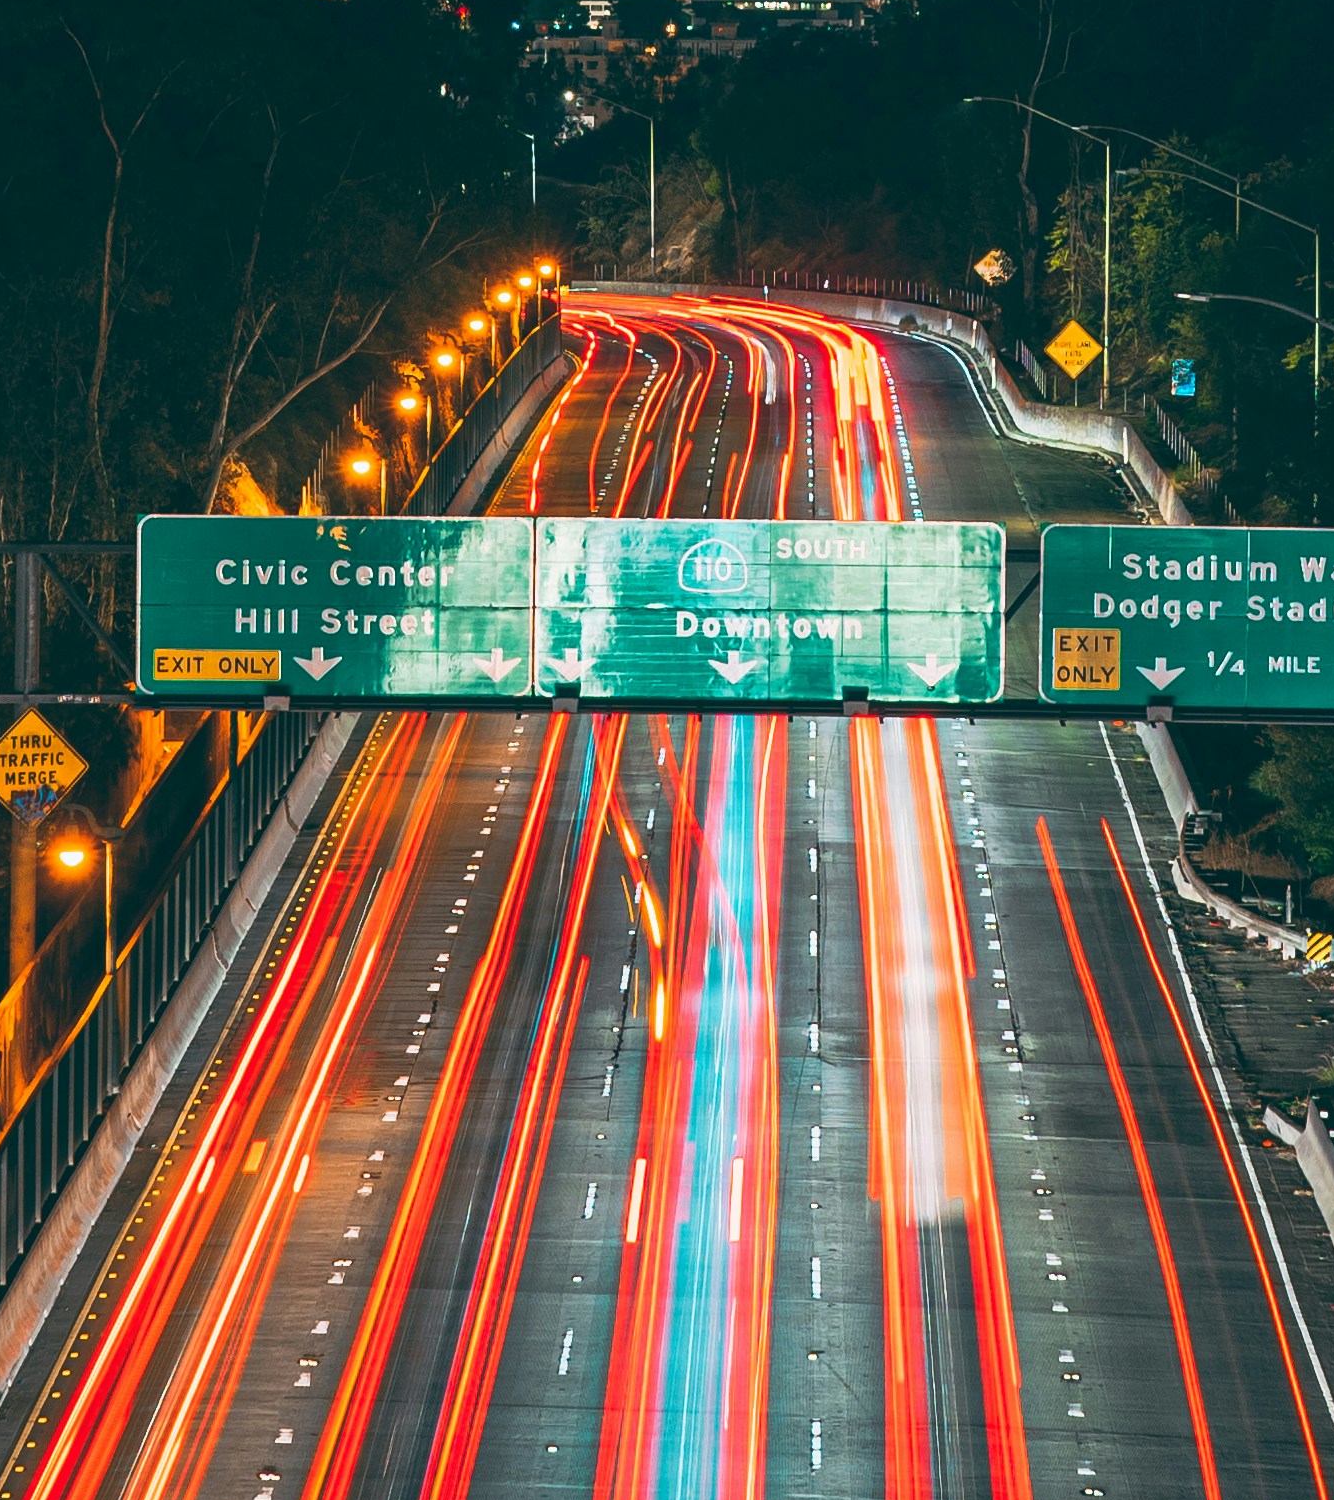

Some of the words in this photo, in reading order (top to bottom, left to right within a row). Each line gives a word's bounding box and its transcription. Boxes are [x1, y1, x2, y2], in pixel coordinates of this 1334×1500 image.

[693, 556, 733, 582] 110
[775, 537, 866, 559] SOUTH
[1122, 553, 1277, 582] Stadium
[215, 559, 309, 586] Civic
[329, 560, 455, 588] Center
[234, 608, 299, 635] Hill
[320, 609, 436, 636] Street
[1093, 592, 1223, 628] Dodger
[676, 610, 863, 639] Downtown
[1059, 635, 1115, 653] EXIT
[156, 656, 204, 674] EXIT
[219, 656, 277, 675] ONLY
[1056, 665, 1115, 684] ONLY
[1207, 651, 1246, 677] 1/4
[1268, 656, 1321, 674] MILE
[10, 734, 52, 749] THRU
[0, 752, 65, 767] TRAFFIC
[5, 770, 57, 785] MERGE
